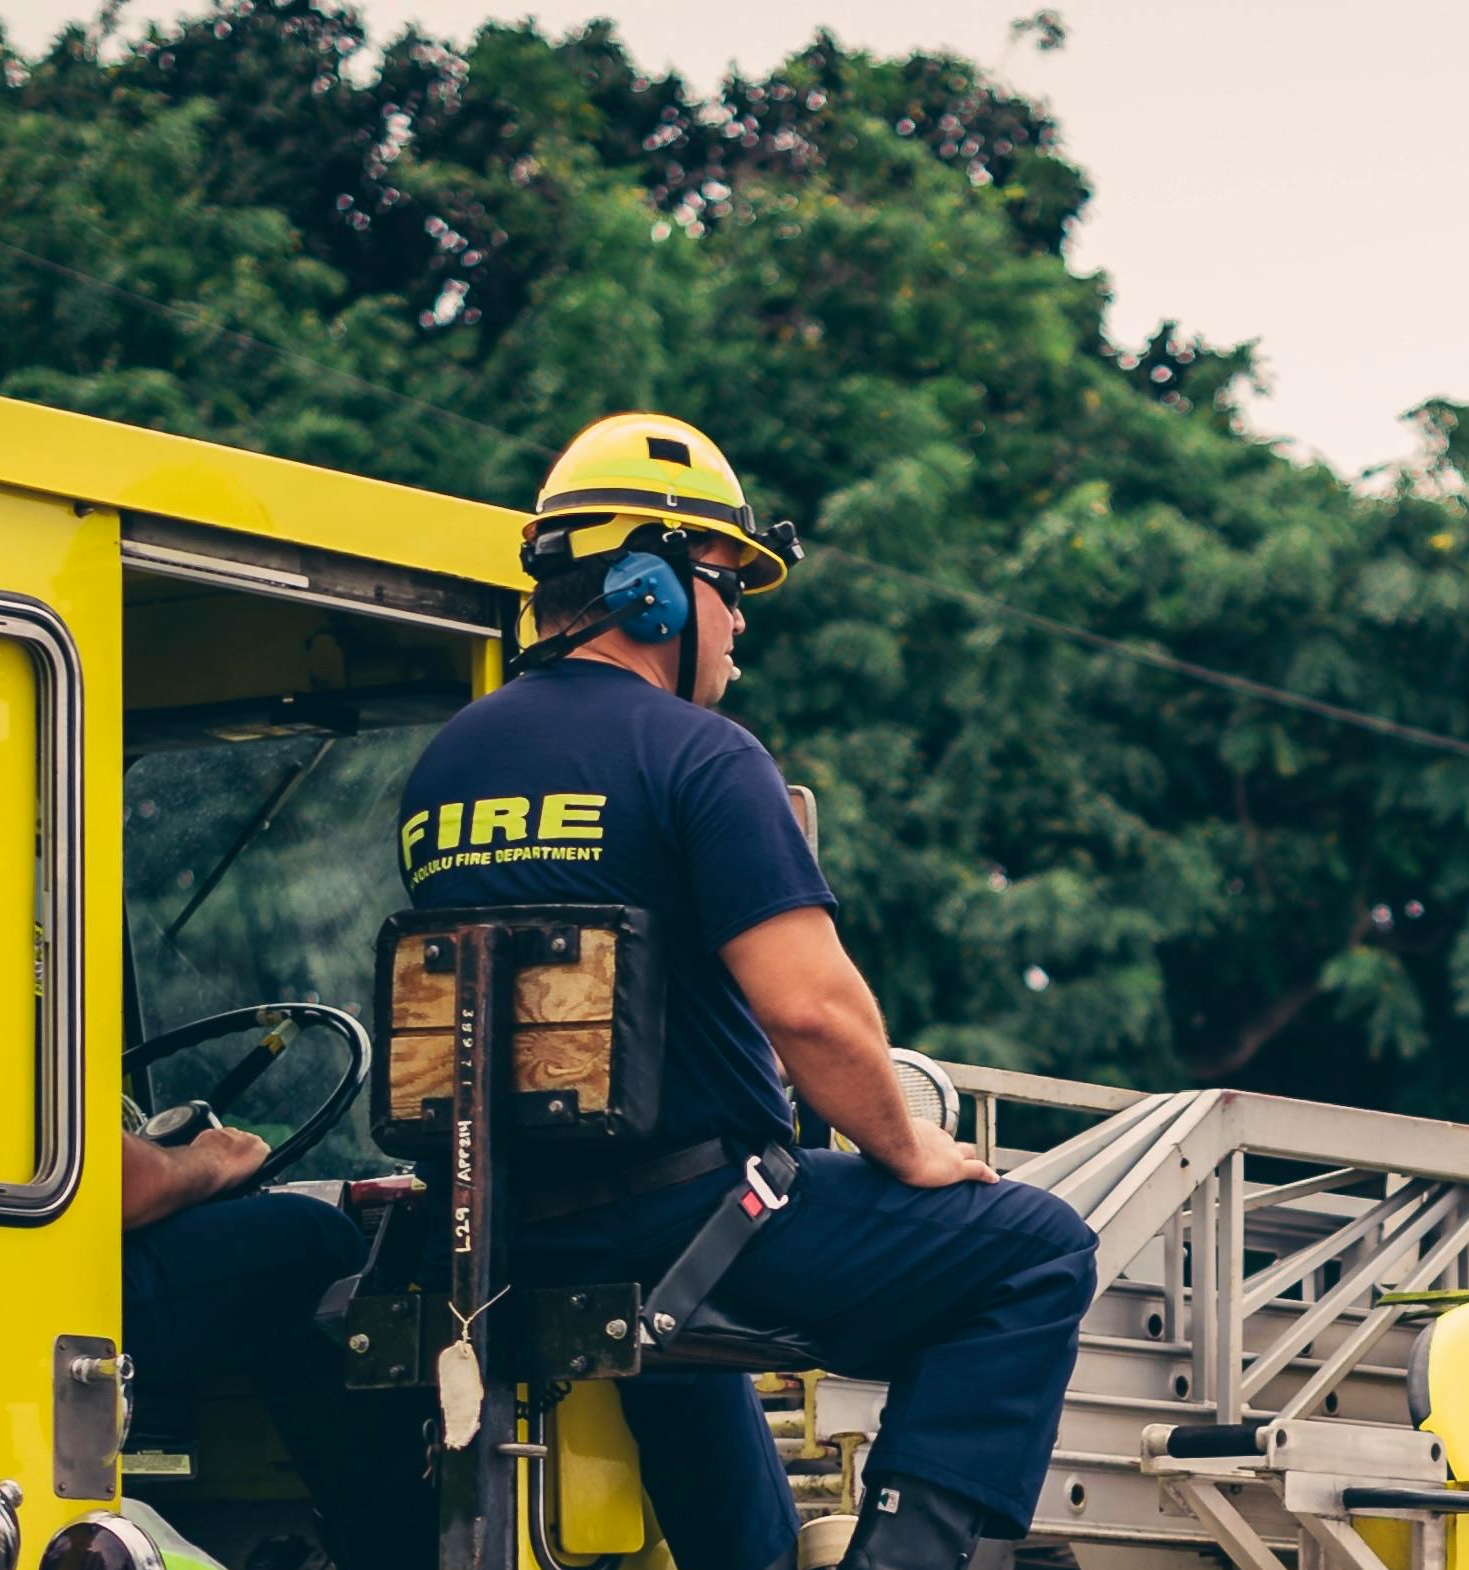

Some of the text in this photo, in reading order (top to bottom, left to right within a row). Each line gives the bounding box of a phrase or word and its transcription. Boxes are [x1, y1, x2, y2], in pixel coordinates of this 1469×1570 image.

[401, 793, 608, 872] FIRE
[455, 852, 492, 868] FIRE
[495, 846, 603, 863] DEPARTMENT
[455, 1206, 472, 1252] L29
